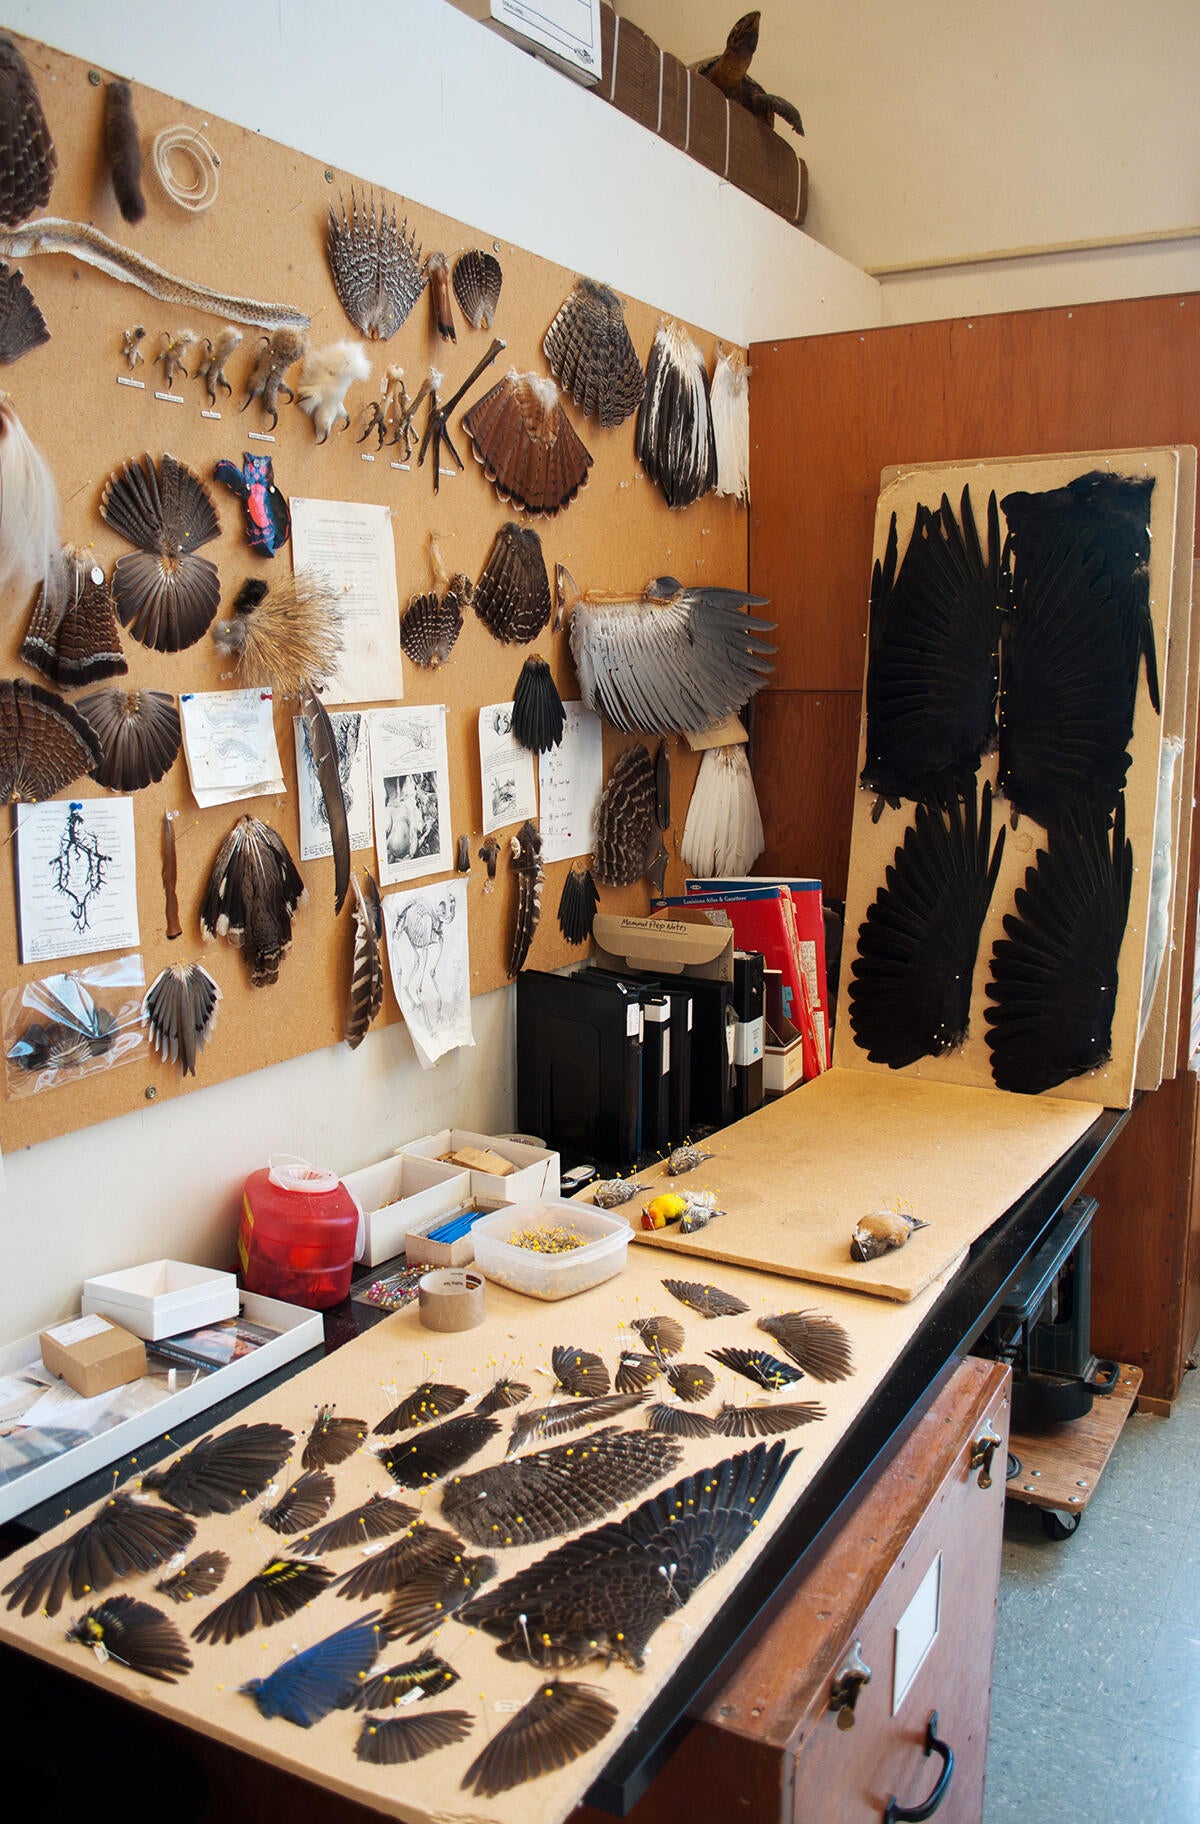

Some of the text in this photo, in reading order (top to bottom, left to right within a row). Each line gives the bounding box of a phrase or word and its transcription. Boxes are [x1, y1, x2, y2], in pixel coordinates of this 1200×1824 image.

[620, 918, 687, 932] Mammal Prep Notes
